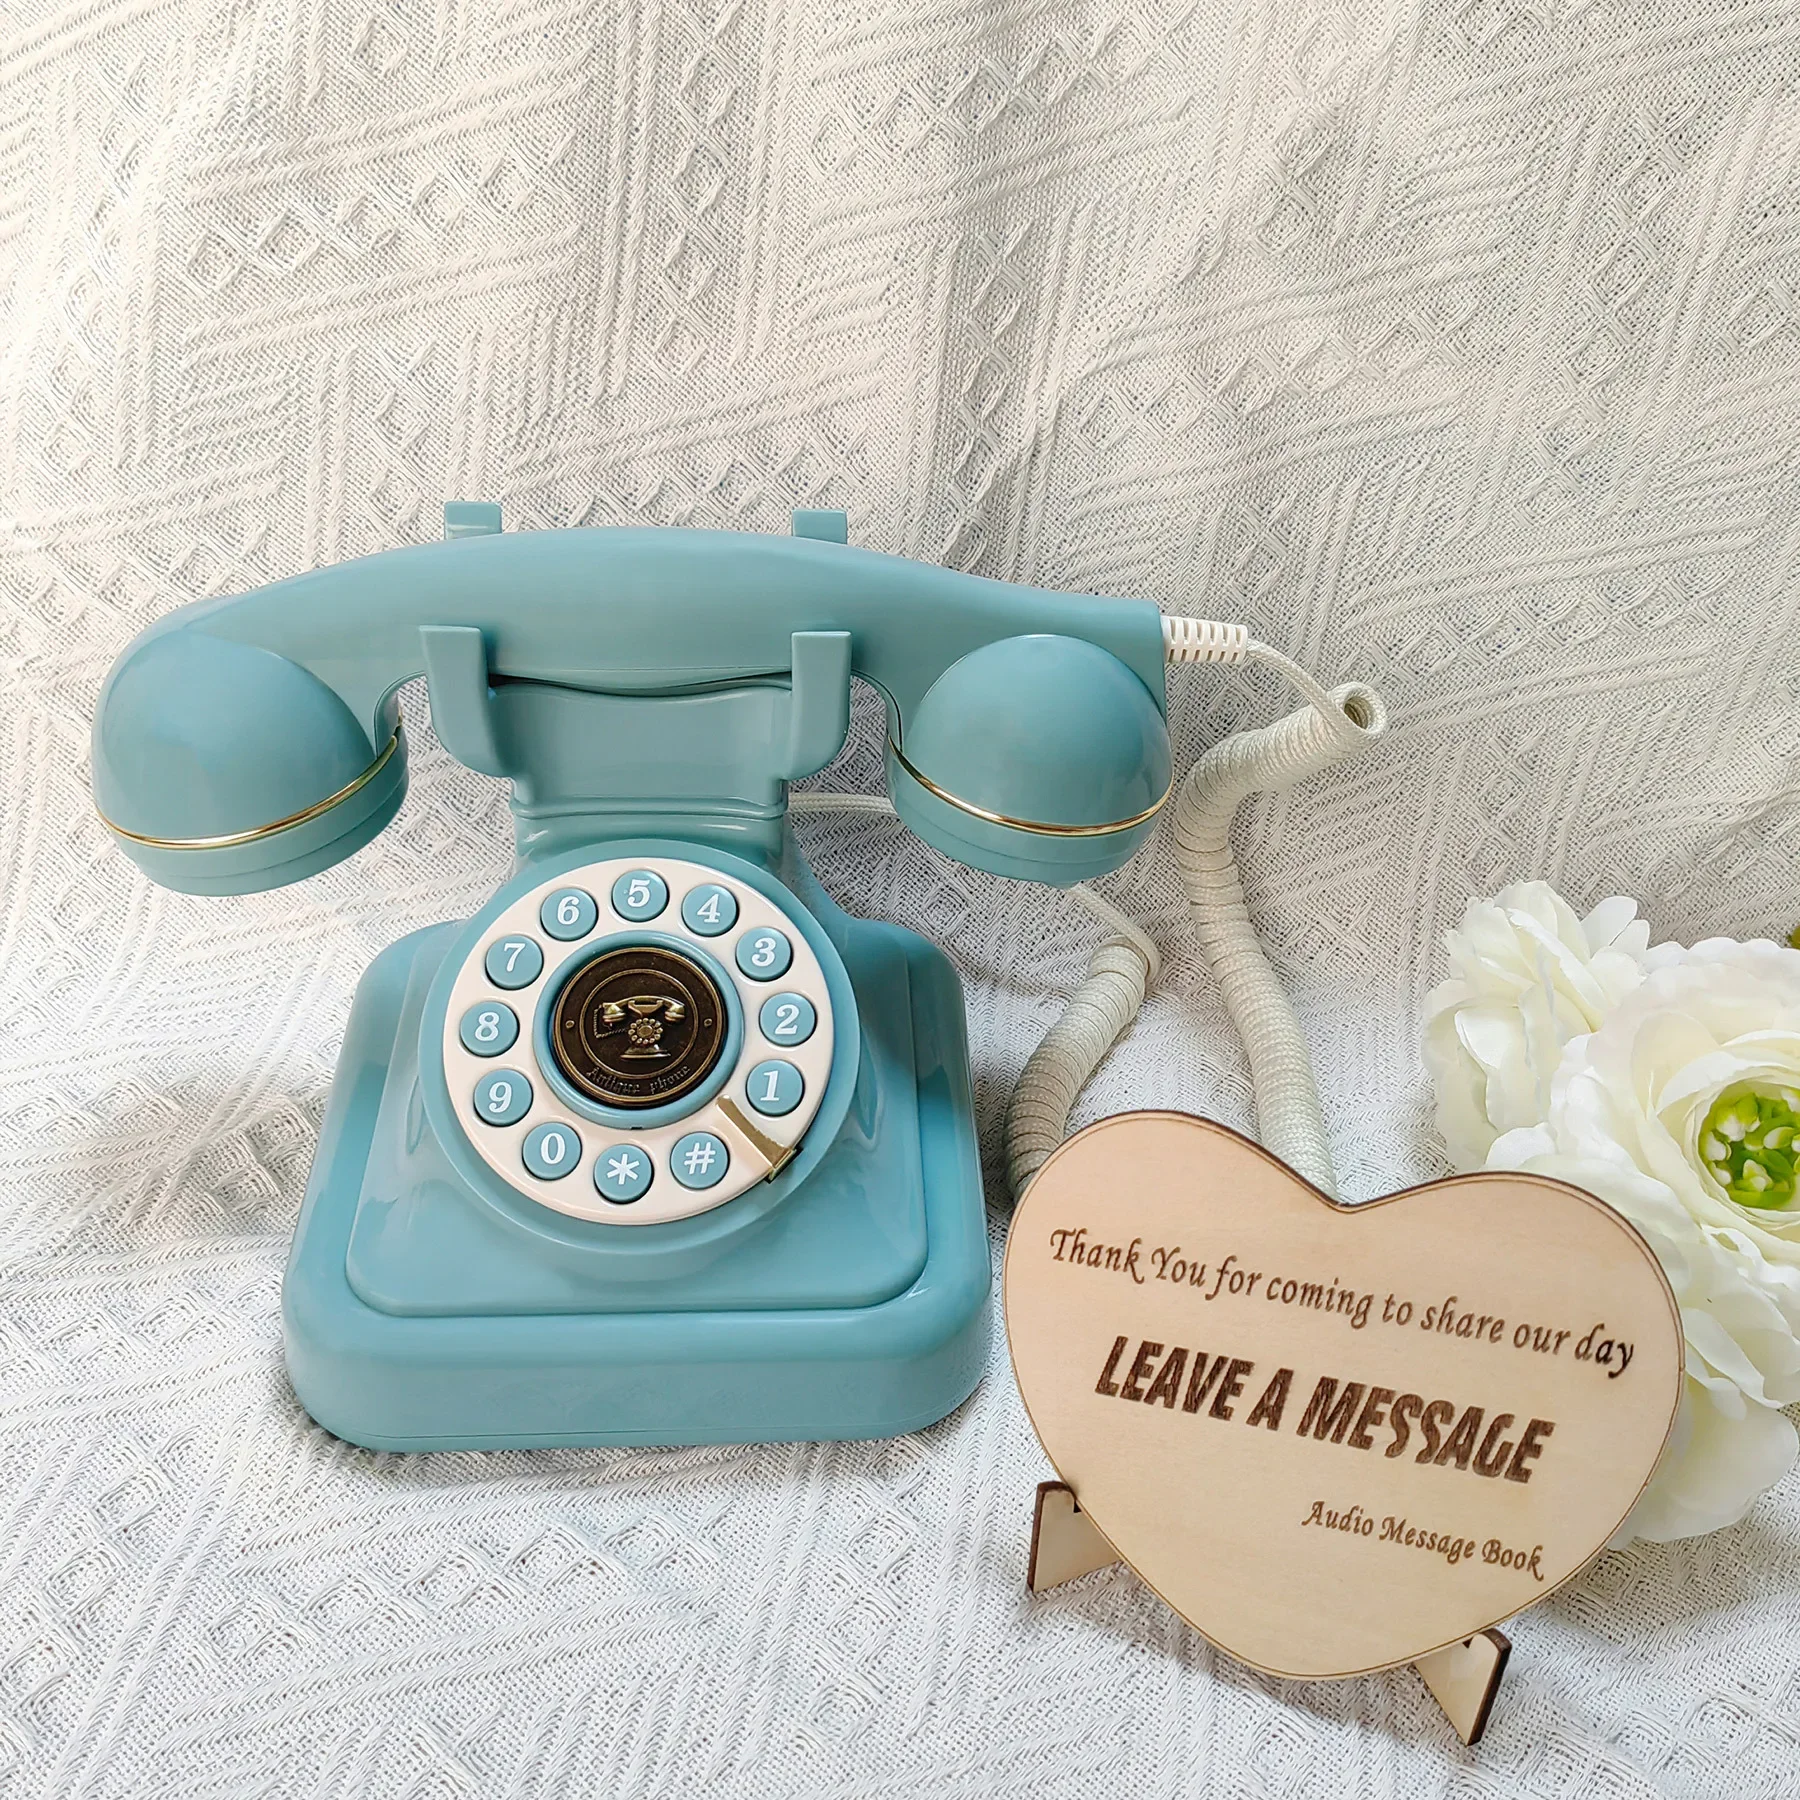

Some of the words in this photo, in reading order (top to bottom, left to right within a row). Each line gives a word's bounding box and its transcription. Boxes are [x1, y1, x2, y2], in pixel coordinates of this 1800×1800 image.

[626, 878, 651, 908] 5
[697, 893, 722, 924] 4
[556, 896, 581, 926] 6
[503, 942, 526, 972] 7
[751, 936, 777, 967] 3
[474, 1011, 500, 1042] 8
[774, 1003, 800, 1035] 2
[487, 1081, 513, 1113] 9
[759, 1070, 781, 1102] 1
[540, 1132, 566, 1165] 0
[1049, 1227, 1145, 1285] Thank
[1150, 1246, 1207, 1288] You
[1204, 1254, 1263, 1301] for
[1265, 1275, 1375, 1330] coming
[1382, 1293, 1413, 1326] to
[1420, 1295, 1505, 1344] share
[1513, 1323, 1571, 1356] our
[1574, 1322, 1635, 1379] day
[1094, 1335, 1255, 1421] LEAVE
[1246, 1367, 1295, 1431] A
[1296, 1375, 1556, 1484] MESSAGE
[1301, 1499, 1375, 1537] Audio
[1379, 1515, 1475, 1566] Message
[1481, 1538, 1545, 1582] Book
